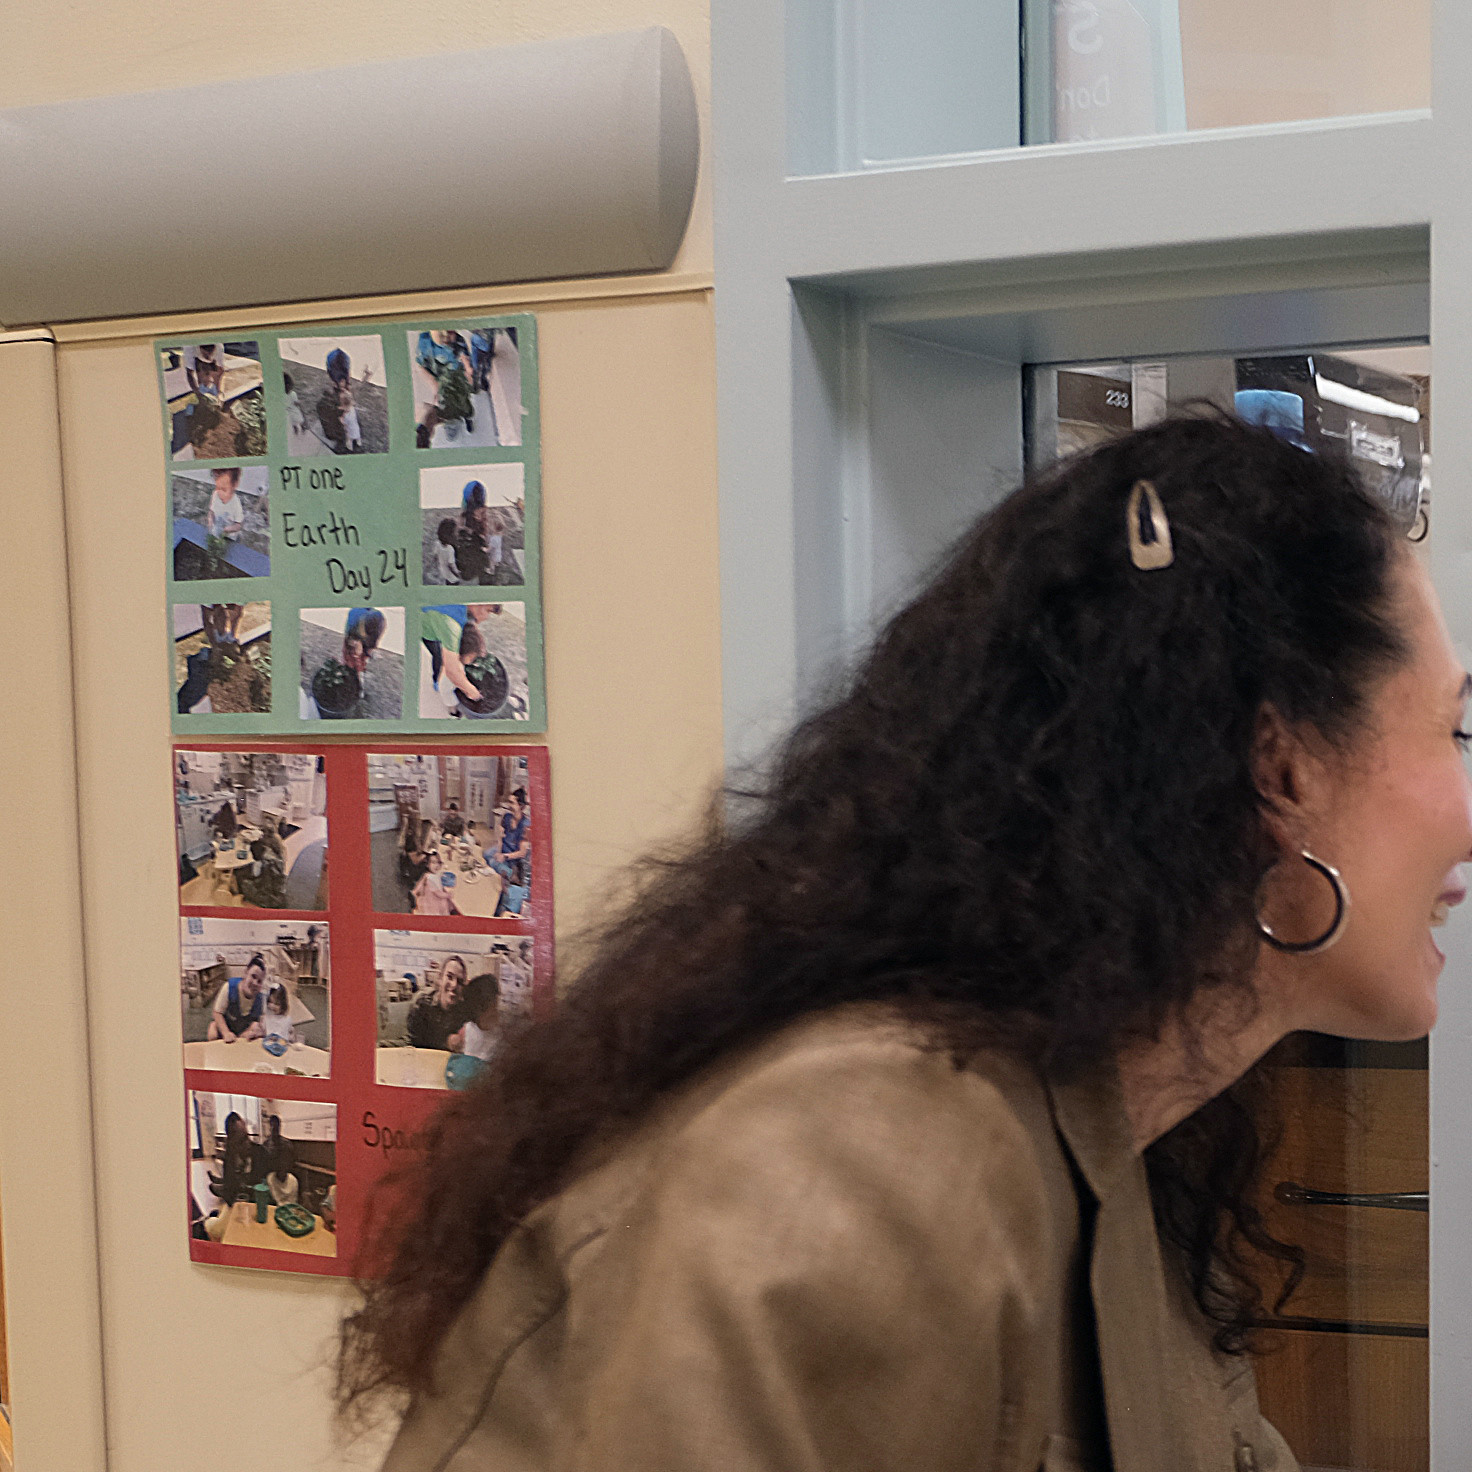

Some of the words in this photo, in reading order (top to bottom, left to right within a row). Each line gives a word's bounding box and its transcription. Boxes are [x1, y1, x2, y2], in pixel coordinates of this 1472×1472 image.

[1106, 389, 1130, 409] 233
[309, 467, 346, 490] one
[282, 511, 360, 548] Earth
[326, 558, 372, 600] Day
[377, 548, 408, 587] 24
